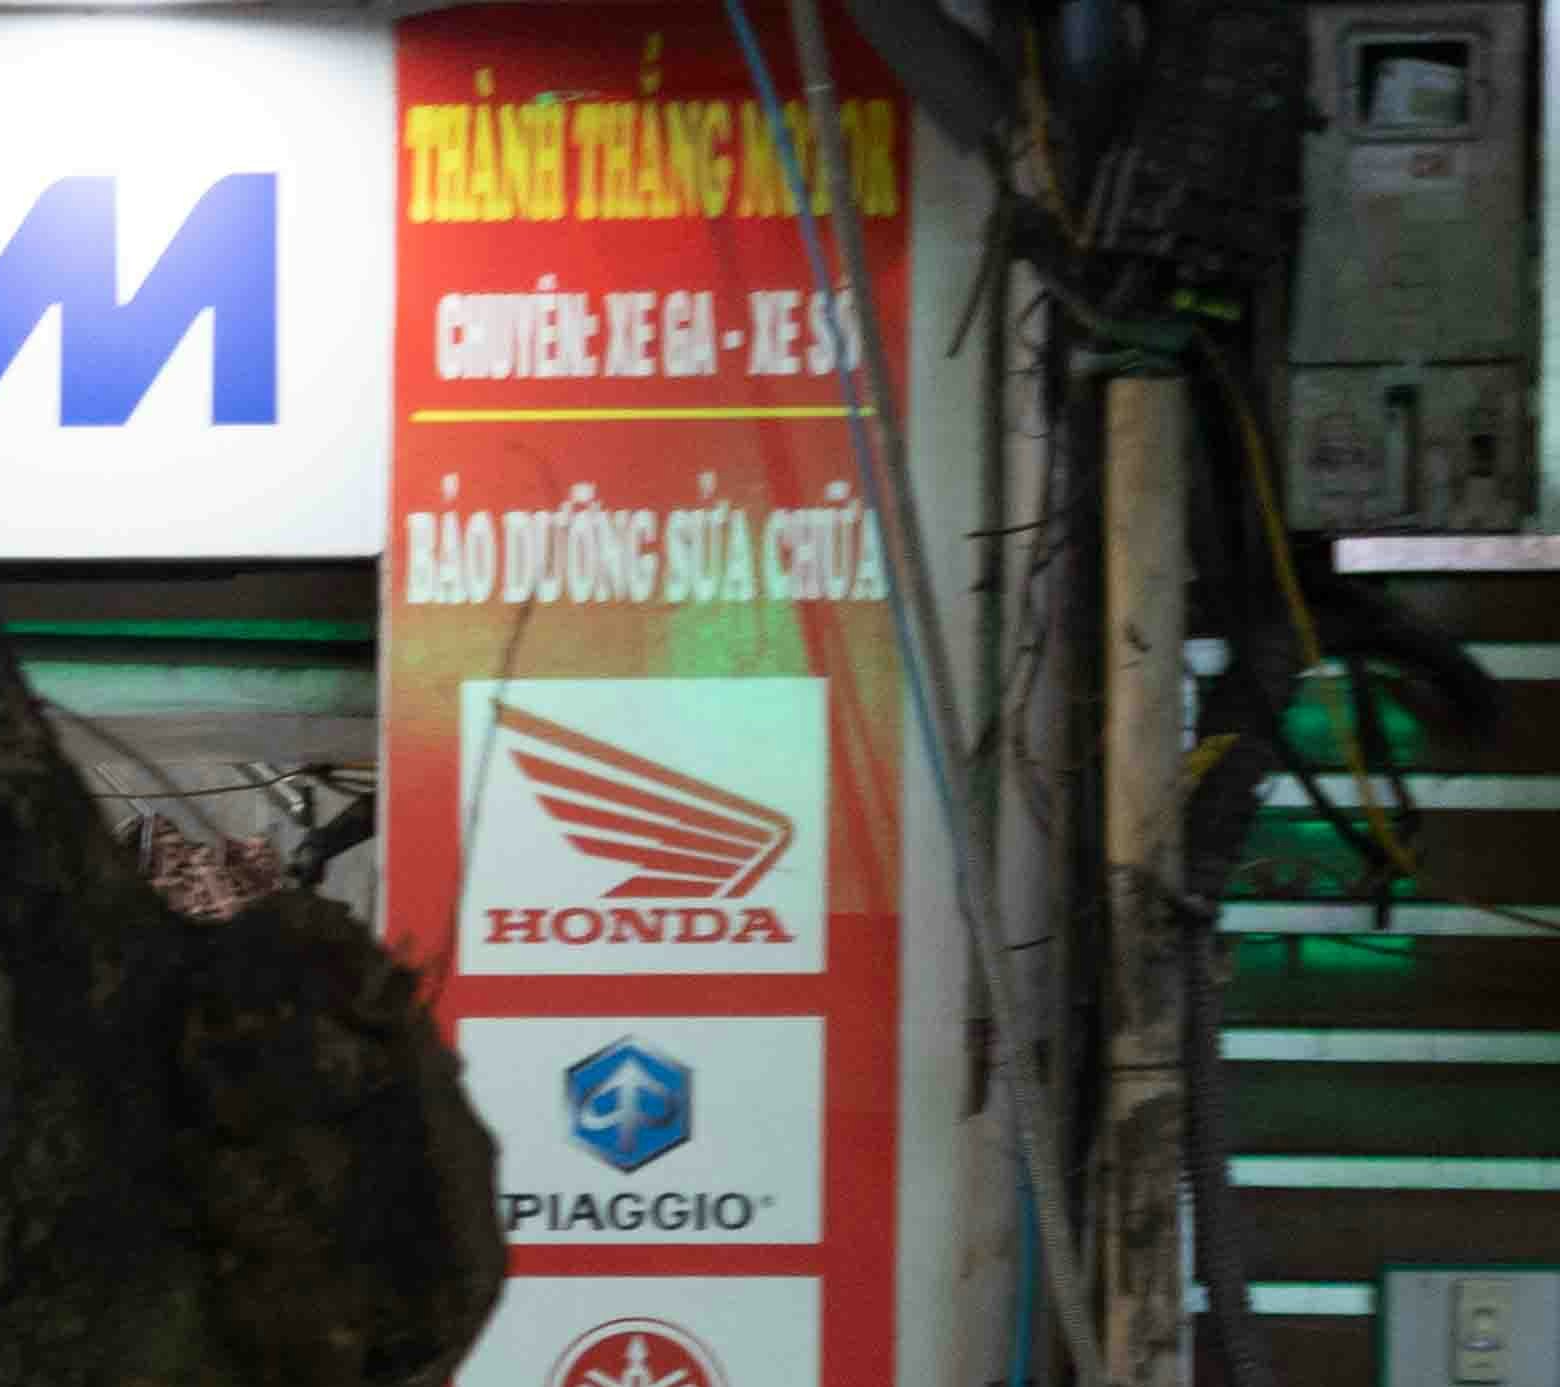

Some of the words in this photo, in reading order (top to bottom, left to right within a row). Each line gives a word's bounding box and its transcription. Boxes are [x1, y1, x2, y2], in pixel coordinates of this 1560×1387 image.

[604, 292, 655, 377] XE
[661, 290, 717, 378] GA
[748, 290, 801, 376] XE
[406, 473, 496, 604] BẢO
[664, 472, 754, 602] SỬA
[483, 908, 794, 945] HONDA
[499, 1192, 754, 1231] PIAGGIO
